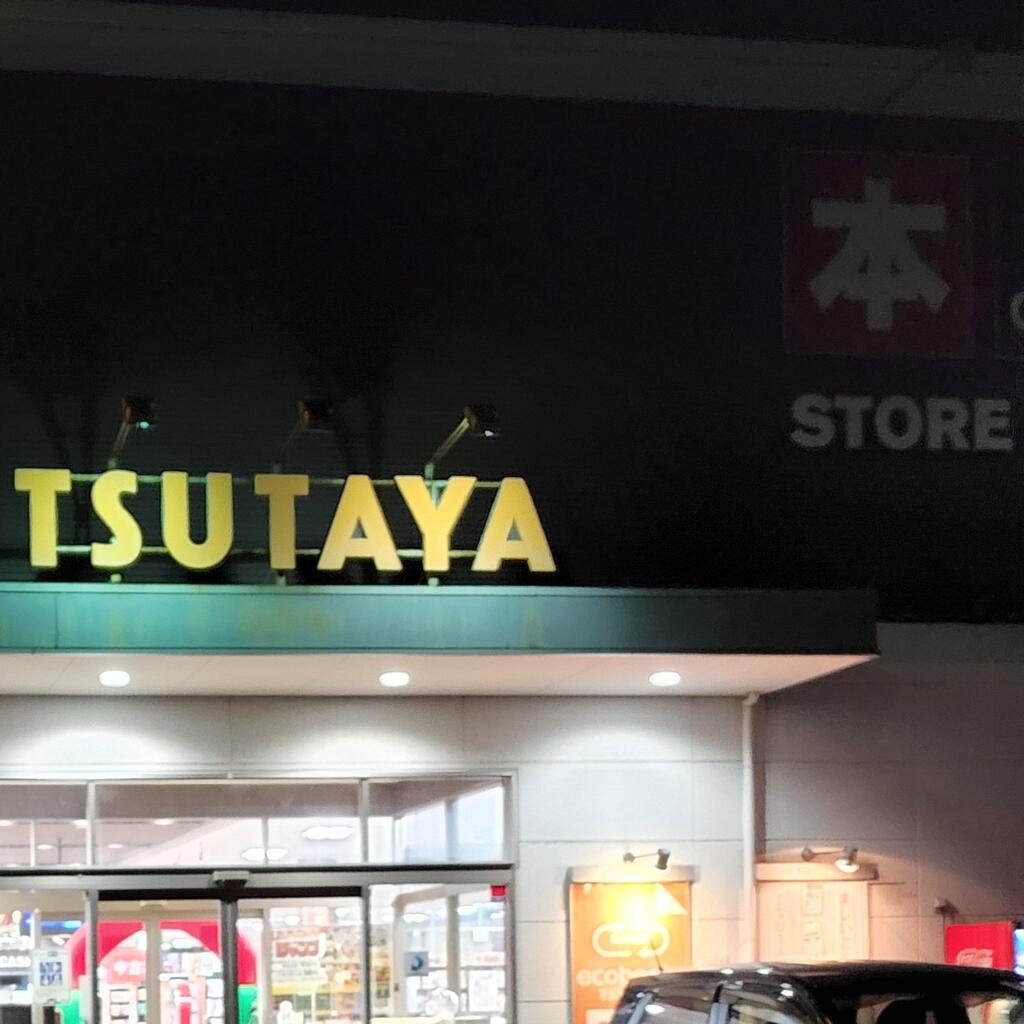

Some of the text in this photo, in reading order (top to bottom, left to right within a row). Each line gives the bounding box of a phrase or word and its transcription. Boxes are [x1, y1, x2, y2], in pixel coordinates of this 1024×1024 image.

[809, 176, 950, 332] 本
[790, 392, 1015, 453] STORE
[14, 468, 556, 573] TSUTAYA
